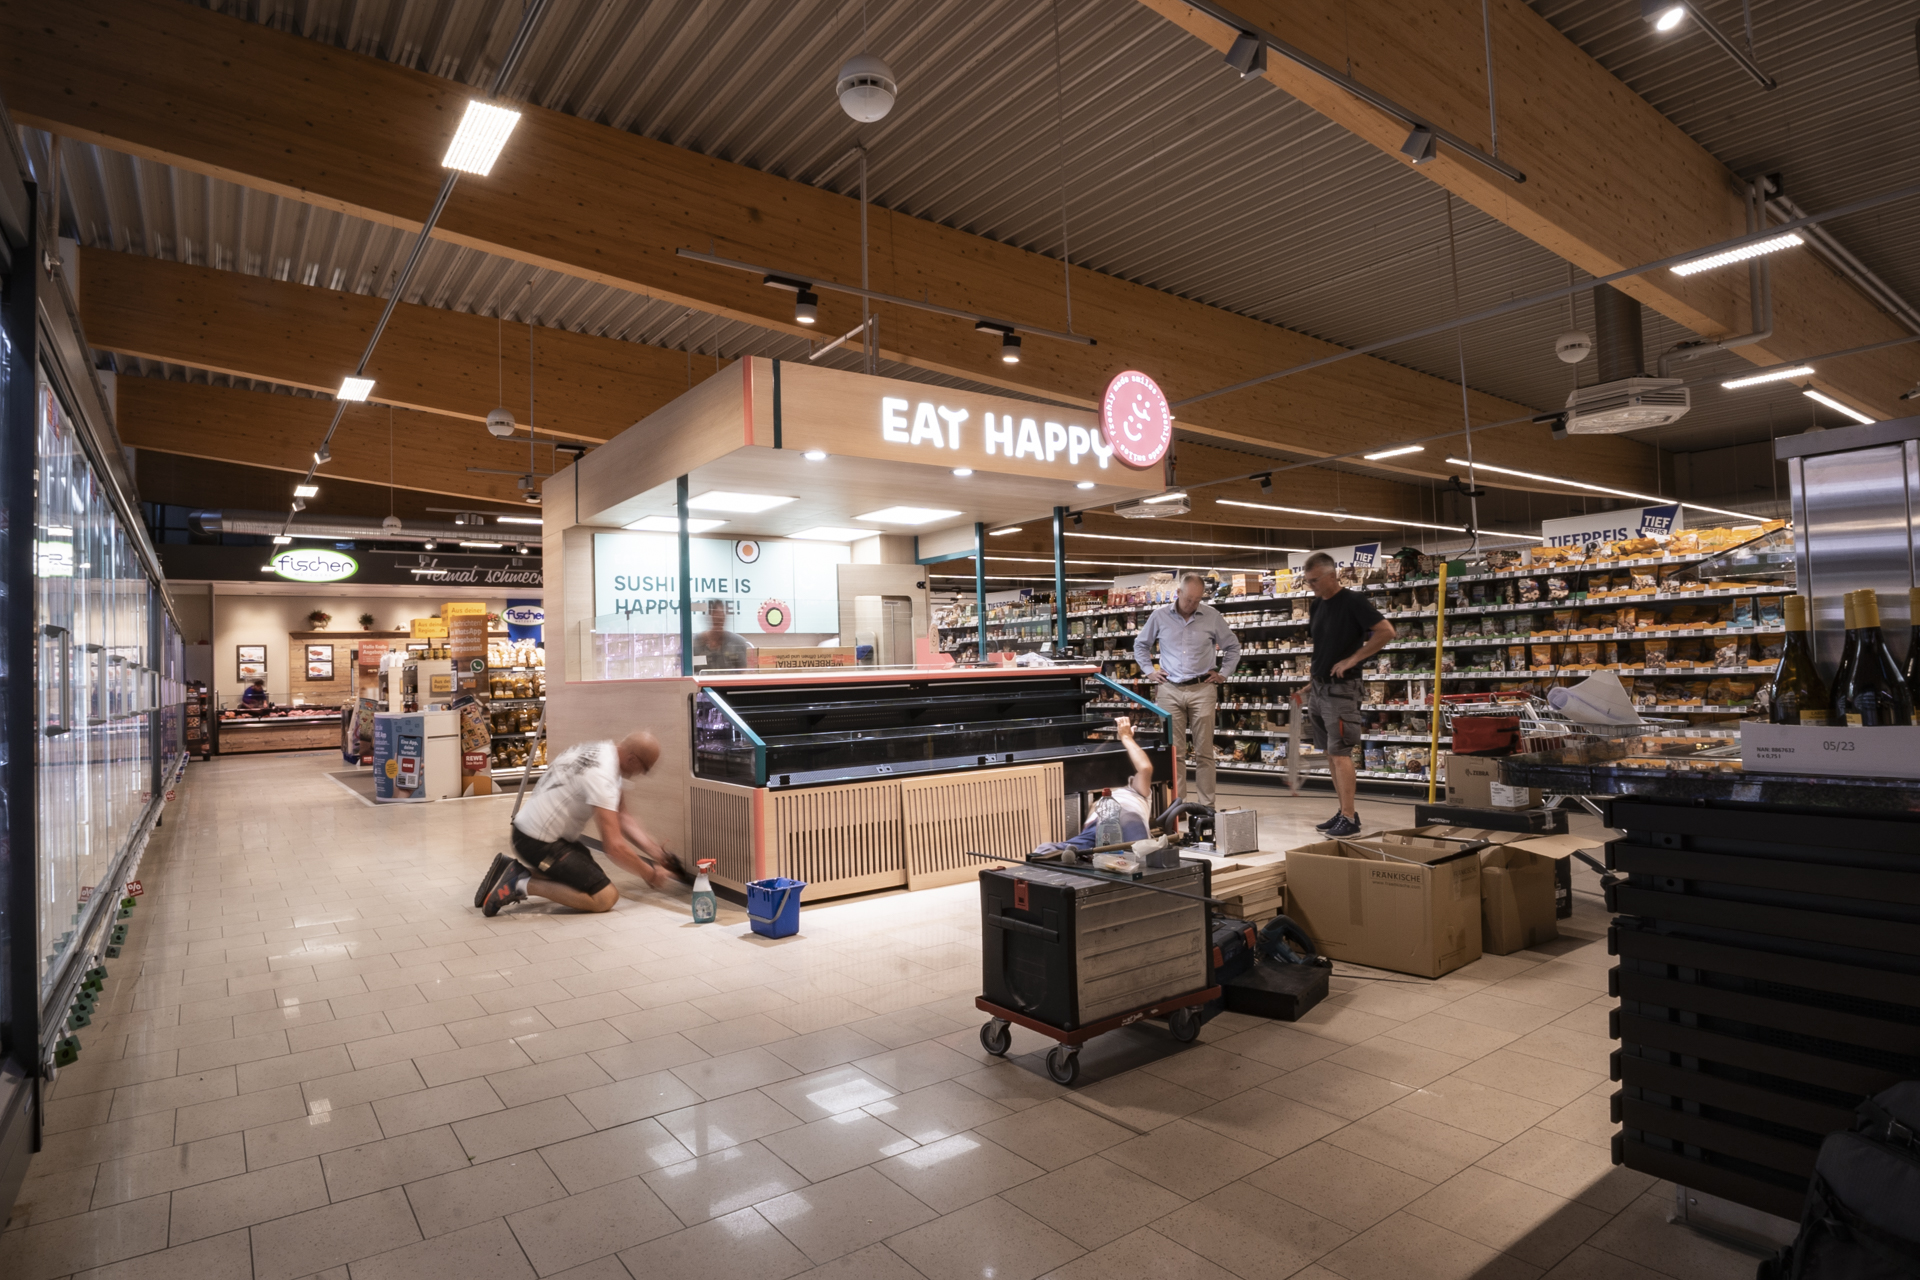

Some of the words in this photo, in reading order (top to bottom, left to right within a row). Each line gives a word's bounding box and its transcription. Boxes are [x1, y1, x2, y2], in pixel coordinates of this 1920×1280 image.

[882, 396, 969, 450] EAT
[984, 411, 1114, 469] HAPPY
[1644, 515, 1671, 528] TIEF
[277, 555, 353, 572] fischer
[1355, 551, 1373, 562] TIEF
[614, 575, 675, 592] SUSHI
[689, 577, 729, 593] IME
[735, 578, 751, 594] IS
[615, 598, 682, 616] HAPPY
[1823, 741, 1855, 751] 05/23
[1372, 870, 1421, 882] FRÄNKISCHE
